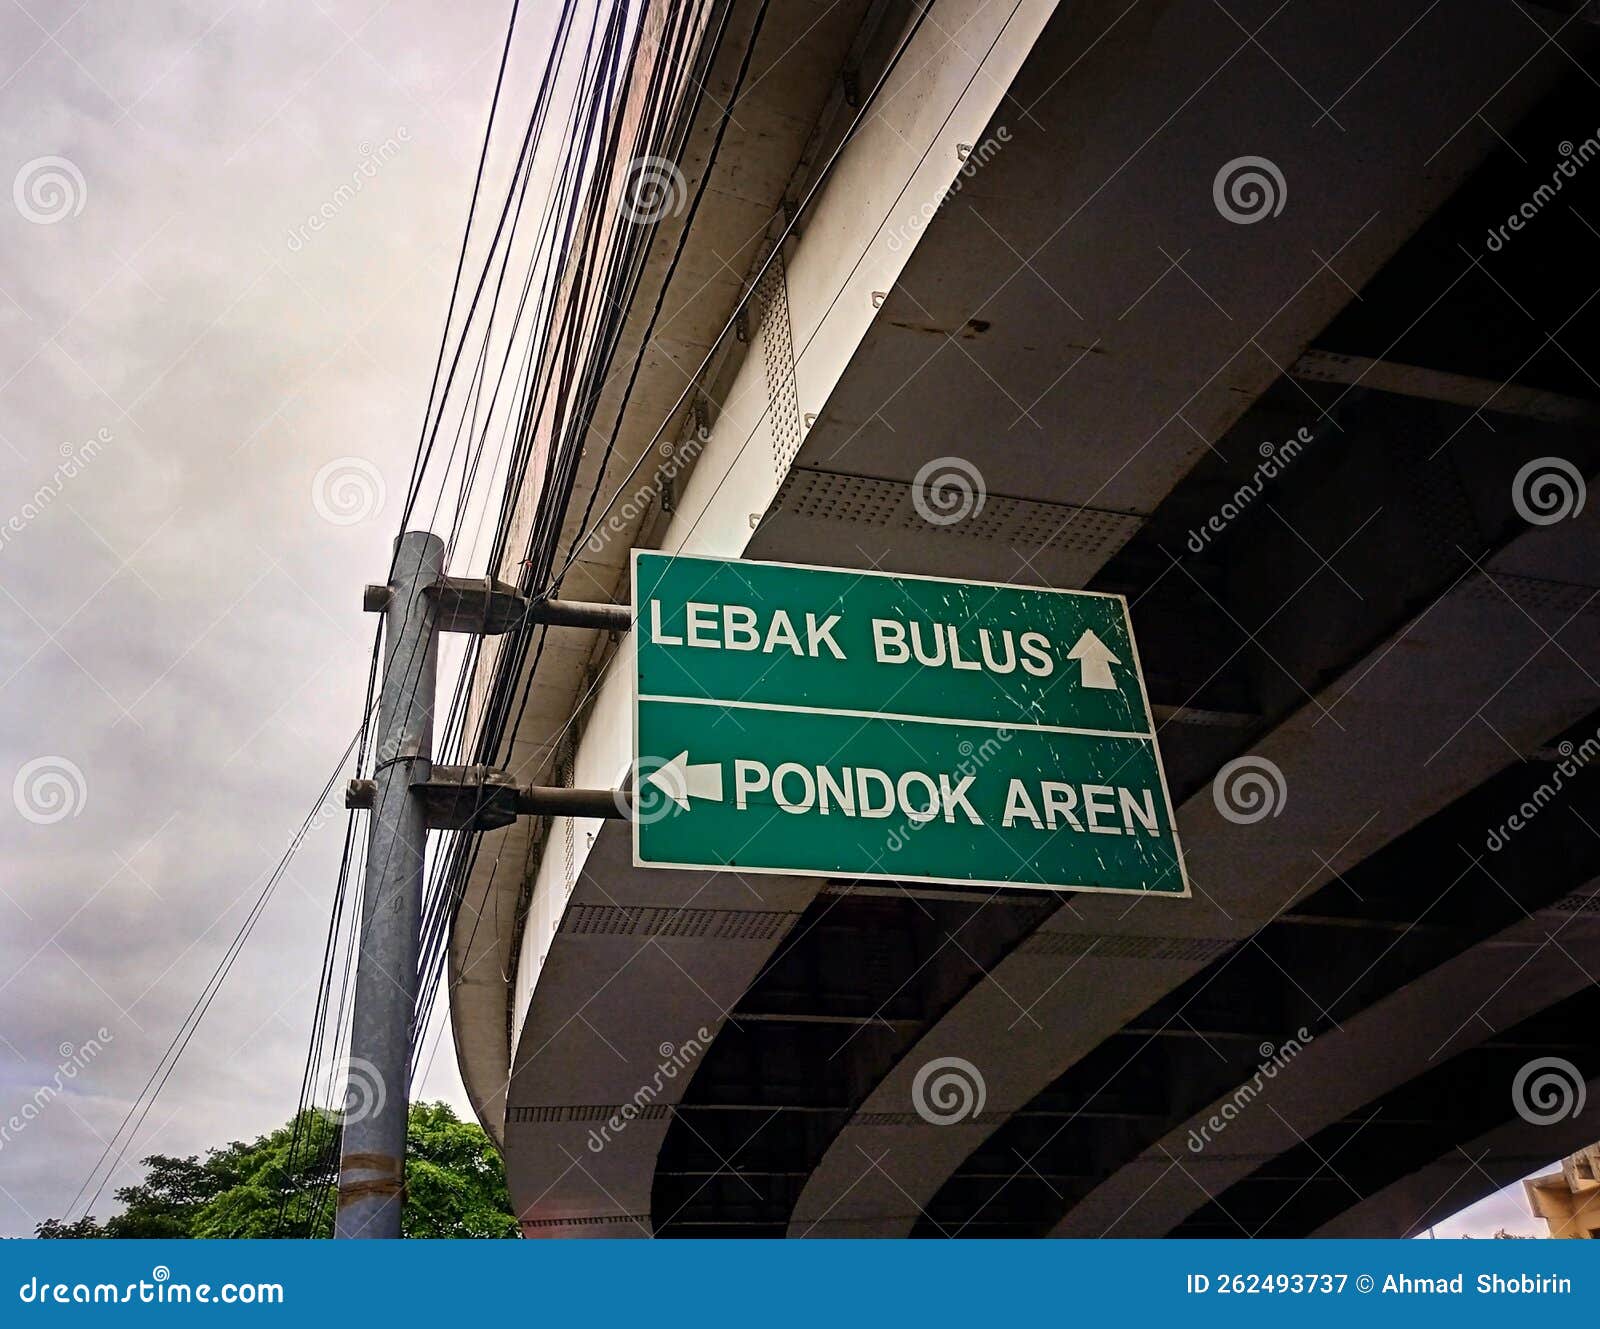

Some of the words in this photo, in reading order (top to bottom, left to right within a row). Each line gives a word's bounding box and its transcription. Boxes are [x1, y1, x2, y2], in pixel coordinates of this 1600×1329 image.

[651, 599, 847, 660] LEBAK
[872, 618, 1054, 677] BULUS
[735, 759, 985, 826] PONDOK
[1002, 778, 1161, 838] AREN
